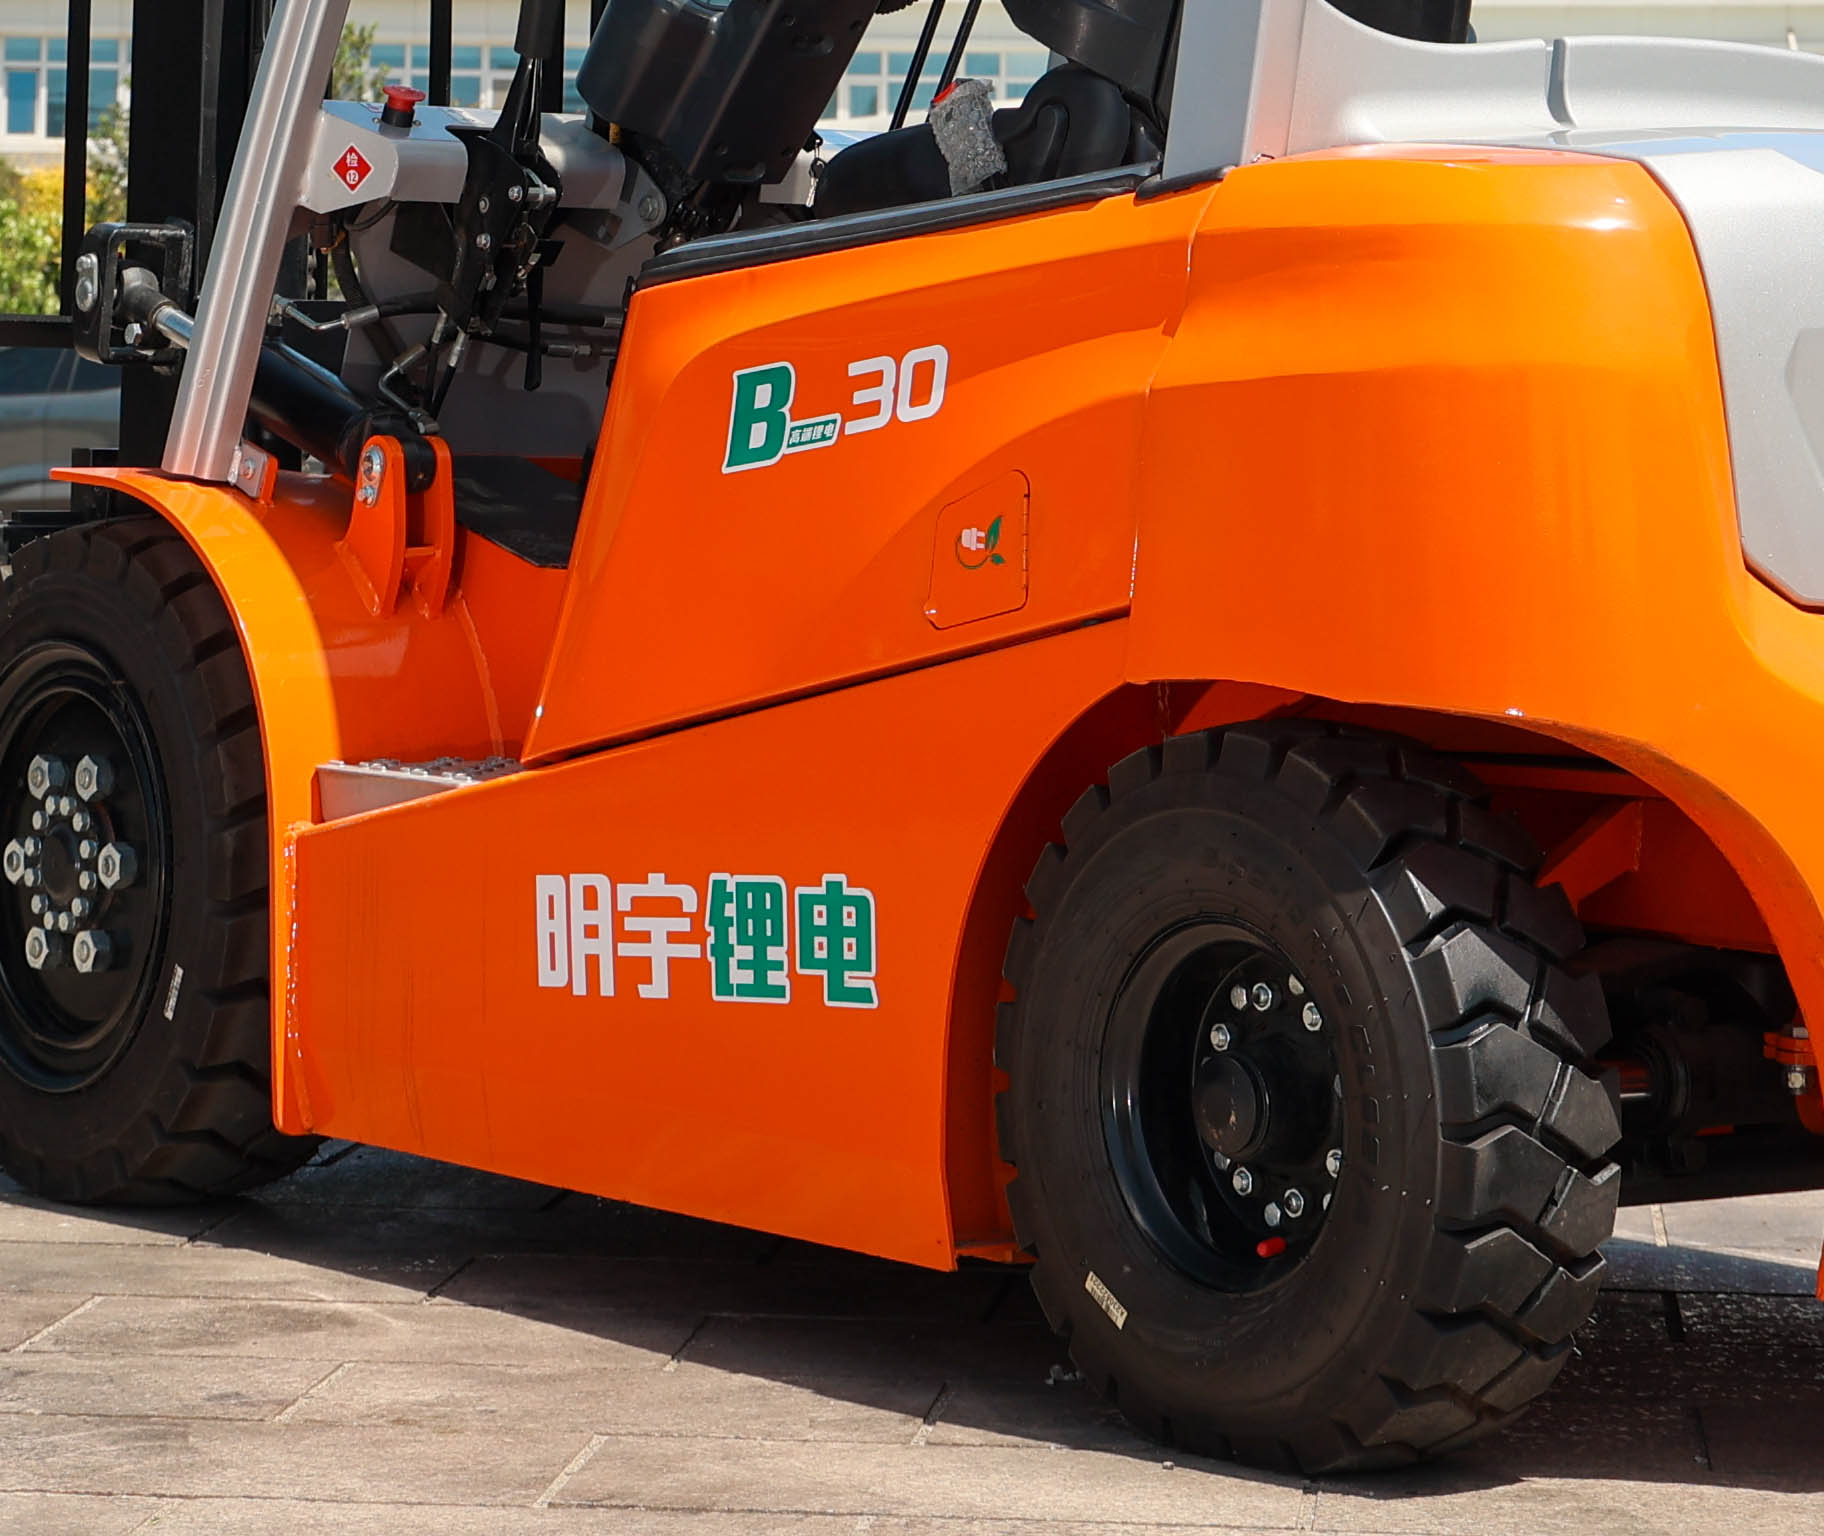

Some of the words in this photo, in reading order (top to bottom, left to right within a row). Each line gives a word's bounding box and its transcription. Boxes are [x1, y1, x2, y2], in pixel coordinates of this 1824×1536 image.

[346, 151, 358, 167] 检
[721, 361, 796, 474] B
[845, 345, 949, 436] 30
[535, 872, 879, 1009] 明宇锂电
